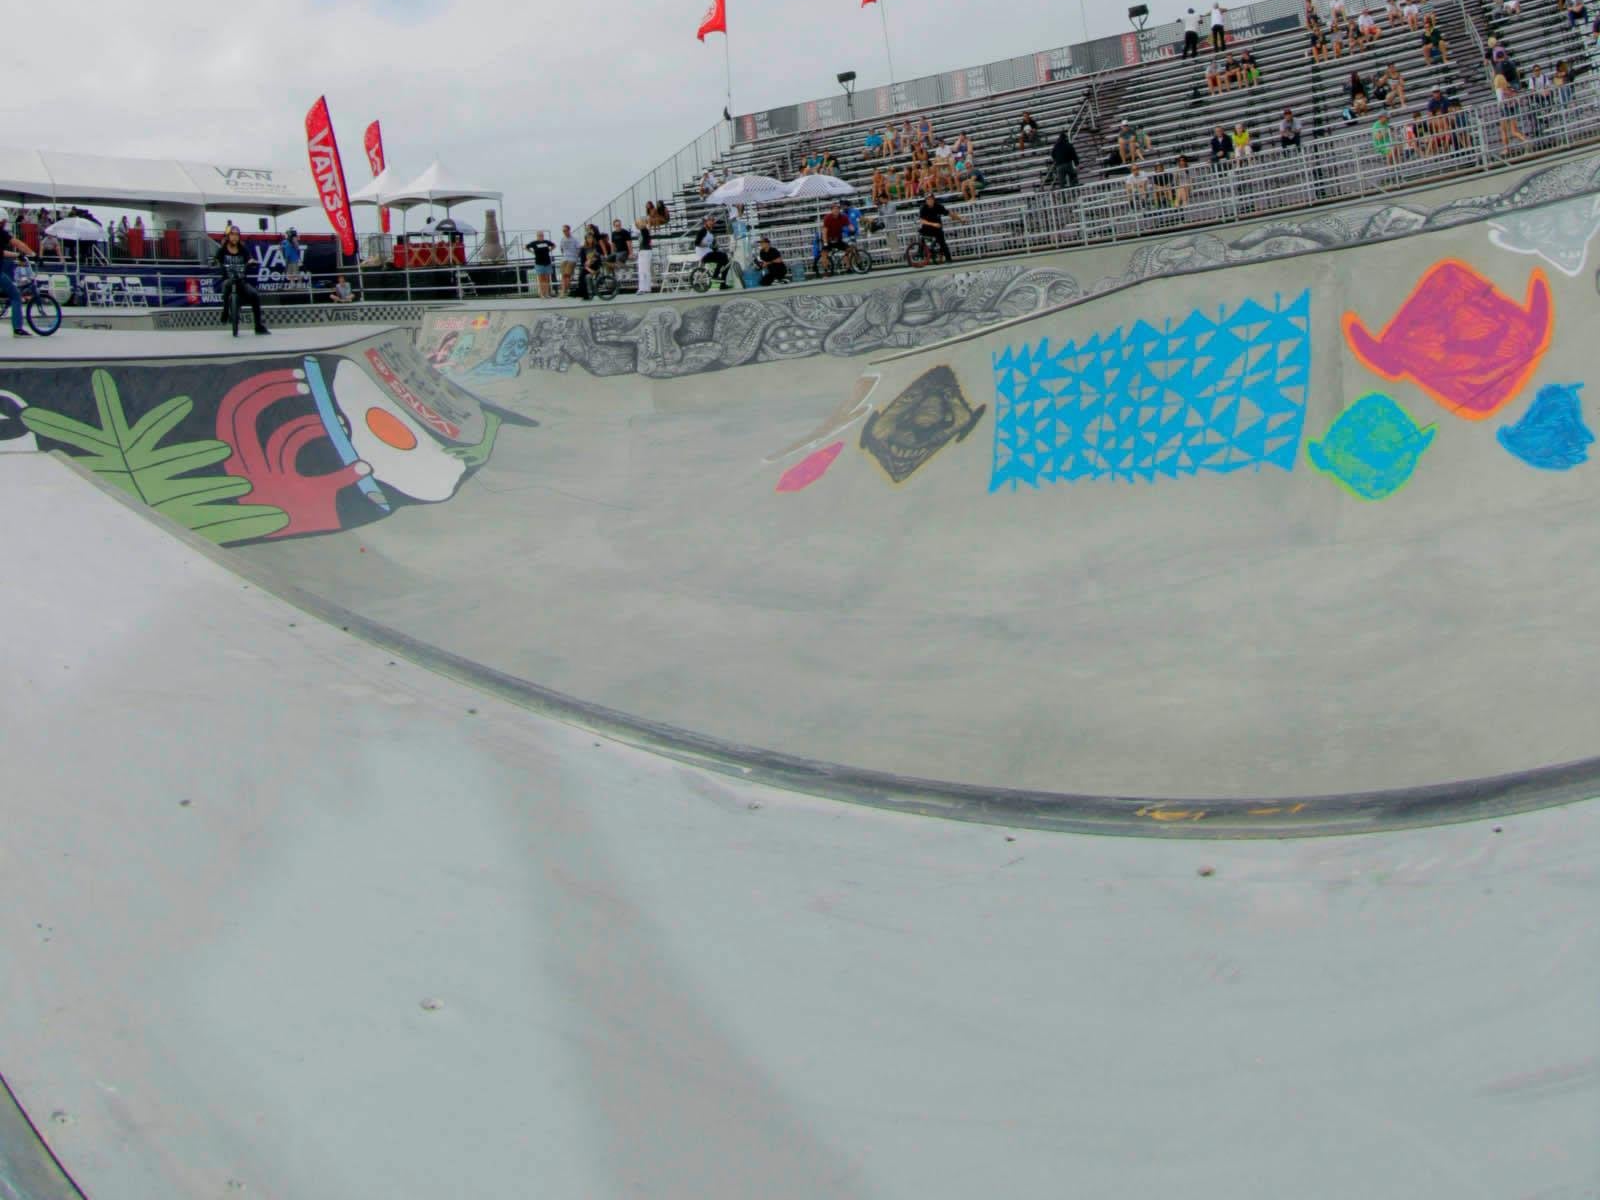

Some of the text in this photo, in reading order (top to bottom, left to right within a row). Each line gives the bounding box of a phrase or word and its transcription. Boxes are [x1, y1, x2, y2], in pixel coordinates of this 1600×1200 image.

[1054, 67, 1081, 81] WALL
[213, 166, 272, 181] VAN
[309, 127, 343, 212] VANS
[325, 309, 358, 322] VANS
